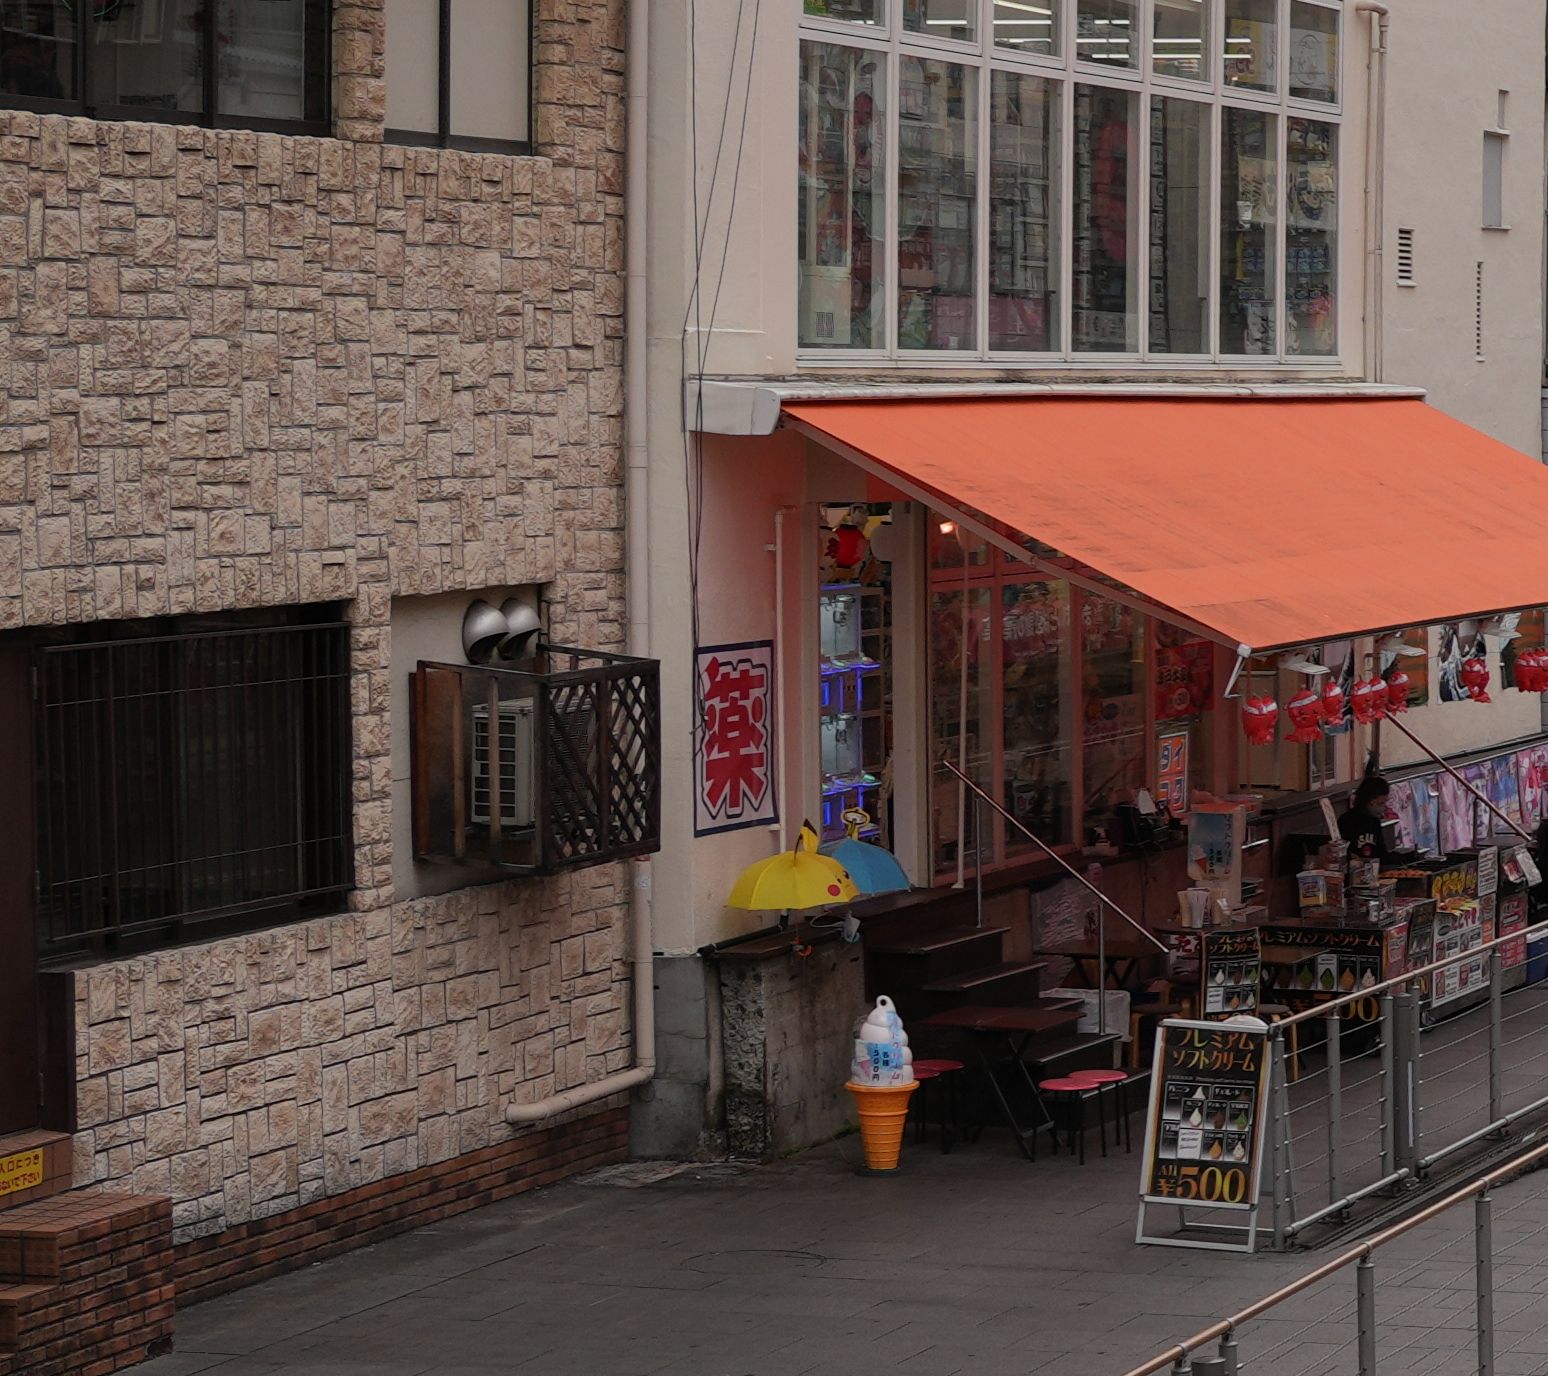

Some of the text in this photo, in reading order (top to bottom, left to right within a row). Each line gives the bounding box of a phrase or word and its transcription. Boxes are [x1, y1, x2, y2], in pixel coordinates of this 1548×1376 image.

[704, 656, 767, 814] 薬
[1173, 1049, 1256, 1073] ソフトクリーム
